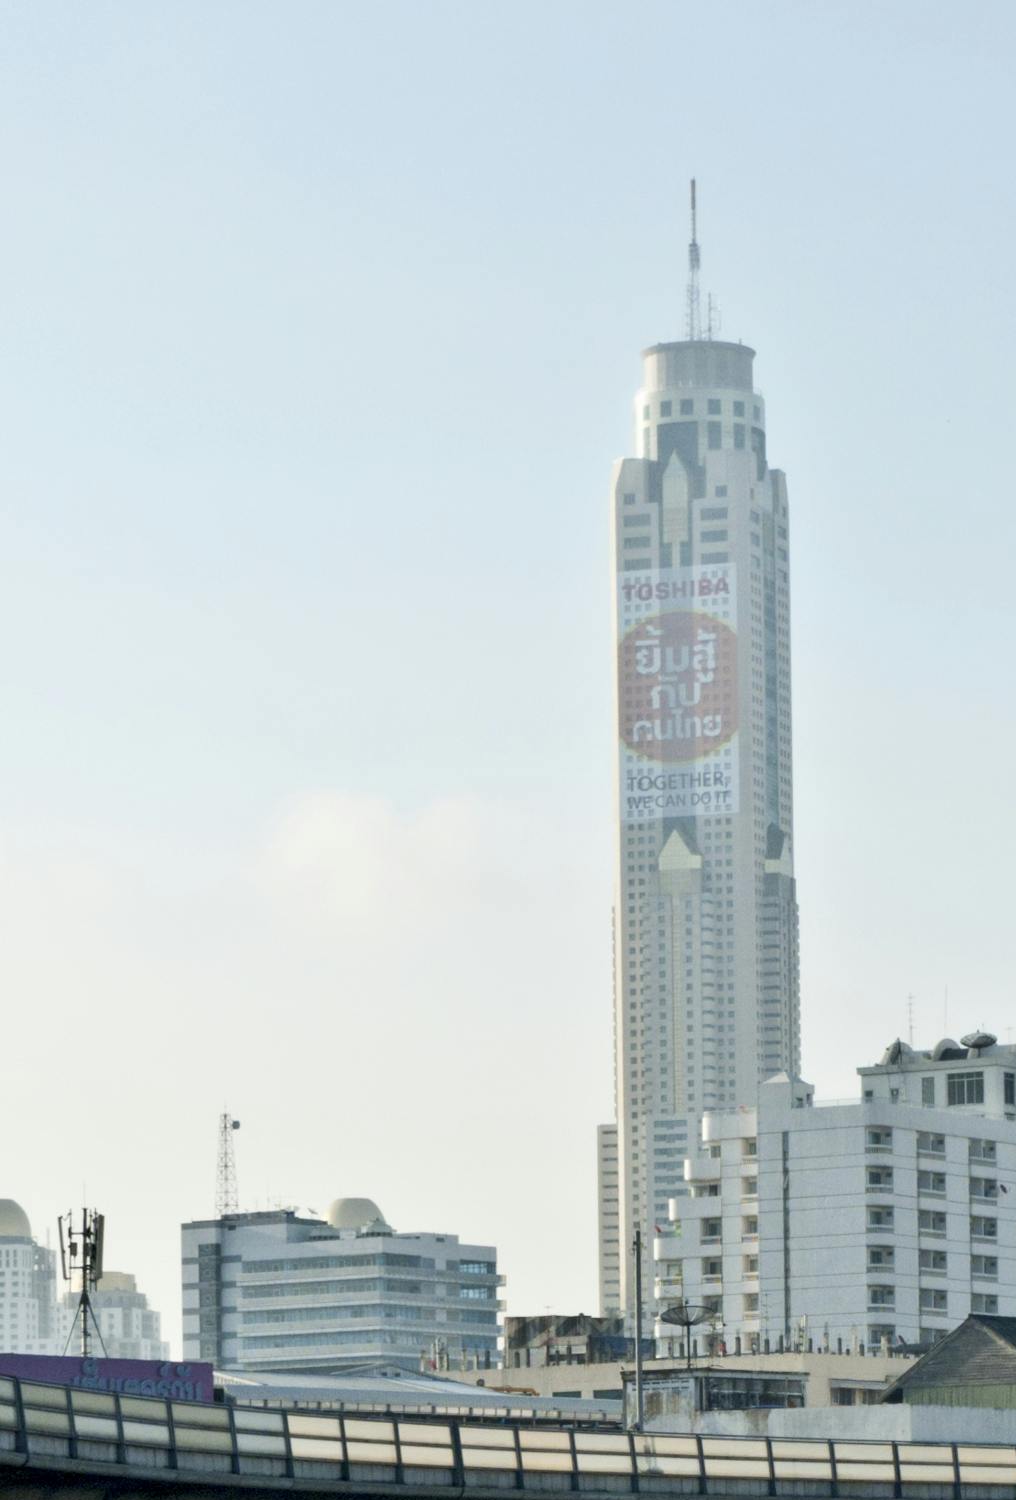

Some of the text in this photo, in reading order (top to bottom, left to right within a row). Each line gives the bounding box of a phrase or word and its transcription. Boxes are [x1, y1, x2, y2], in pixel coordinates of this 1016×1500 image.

[622, 577, 730, 601] TOSHIBA
[633, 709, 722, 742] คนไทย
[627, 771, 729, 793] TOGETHER,
[627, 790, 730, 810] WE CAN DO IT
